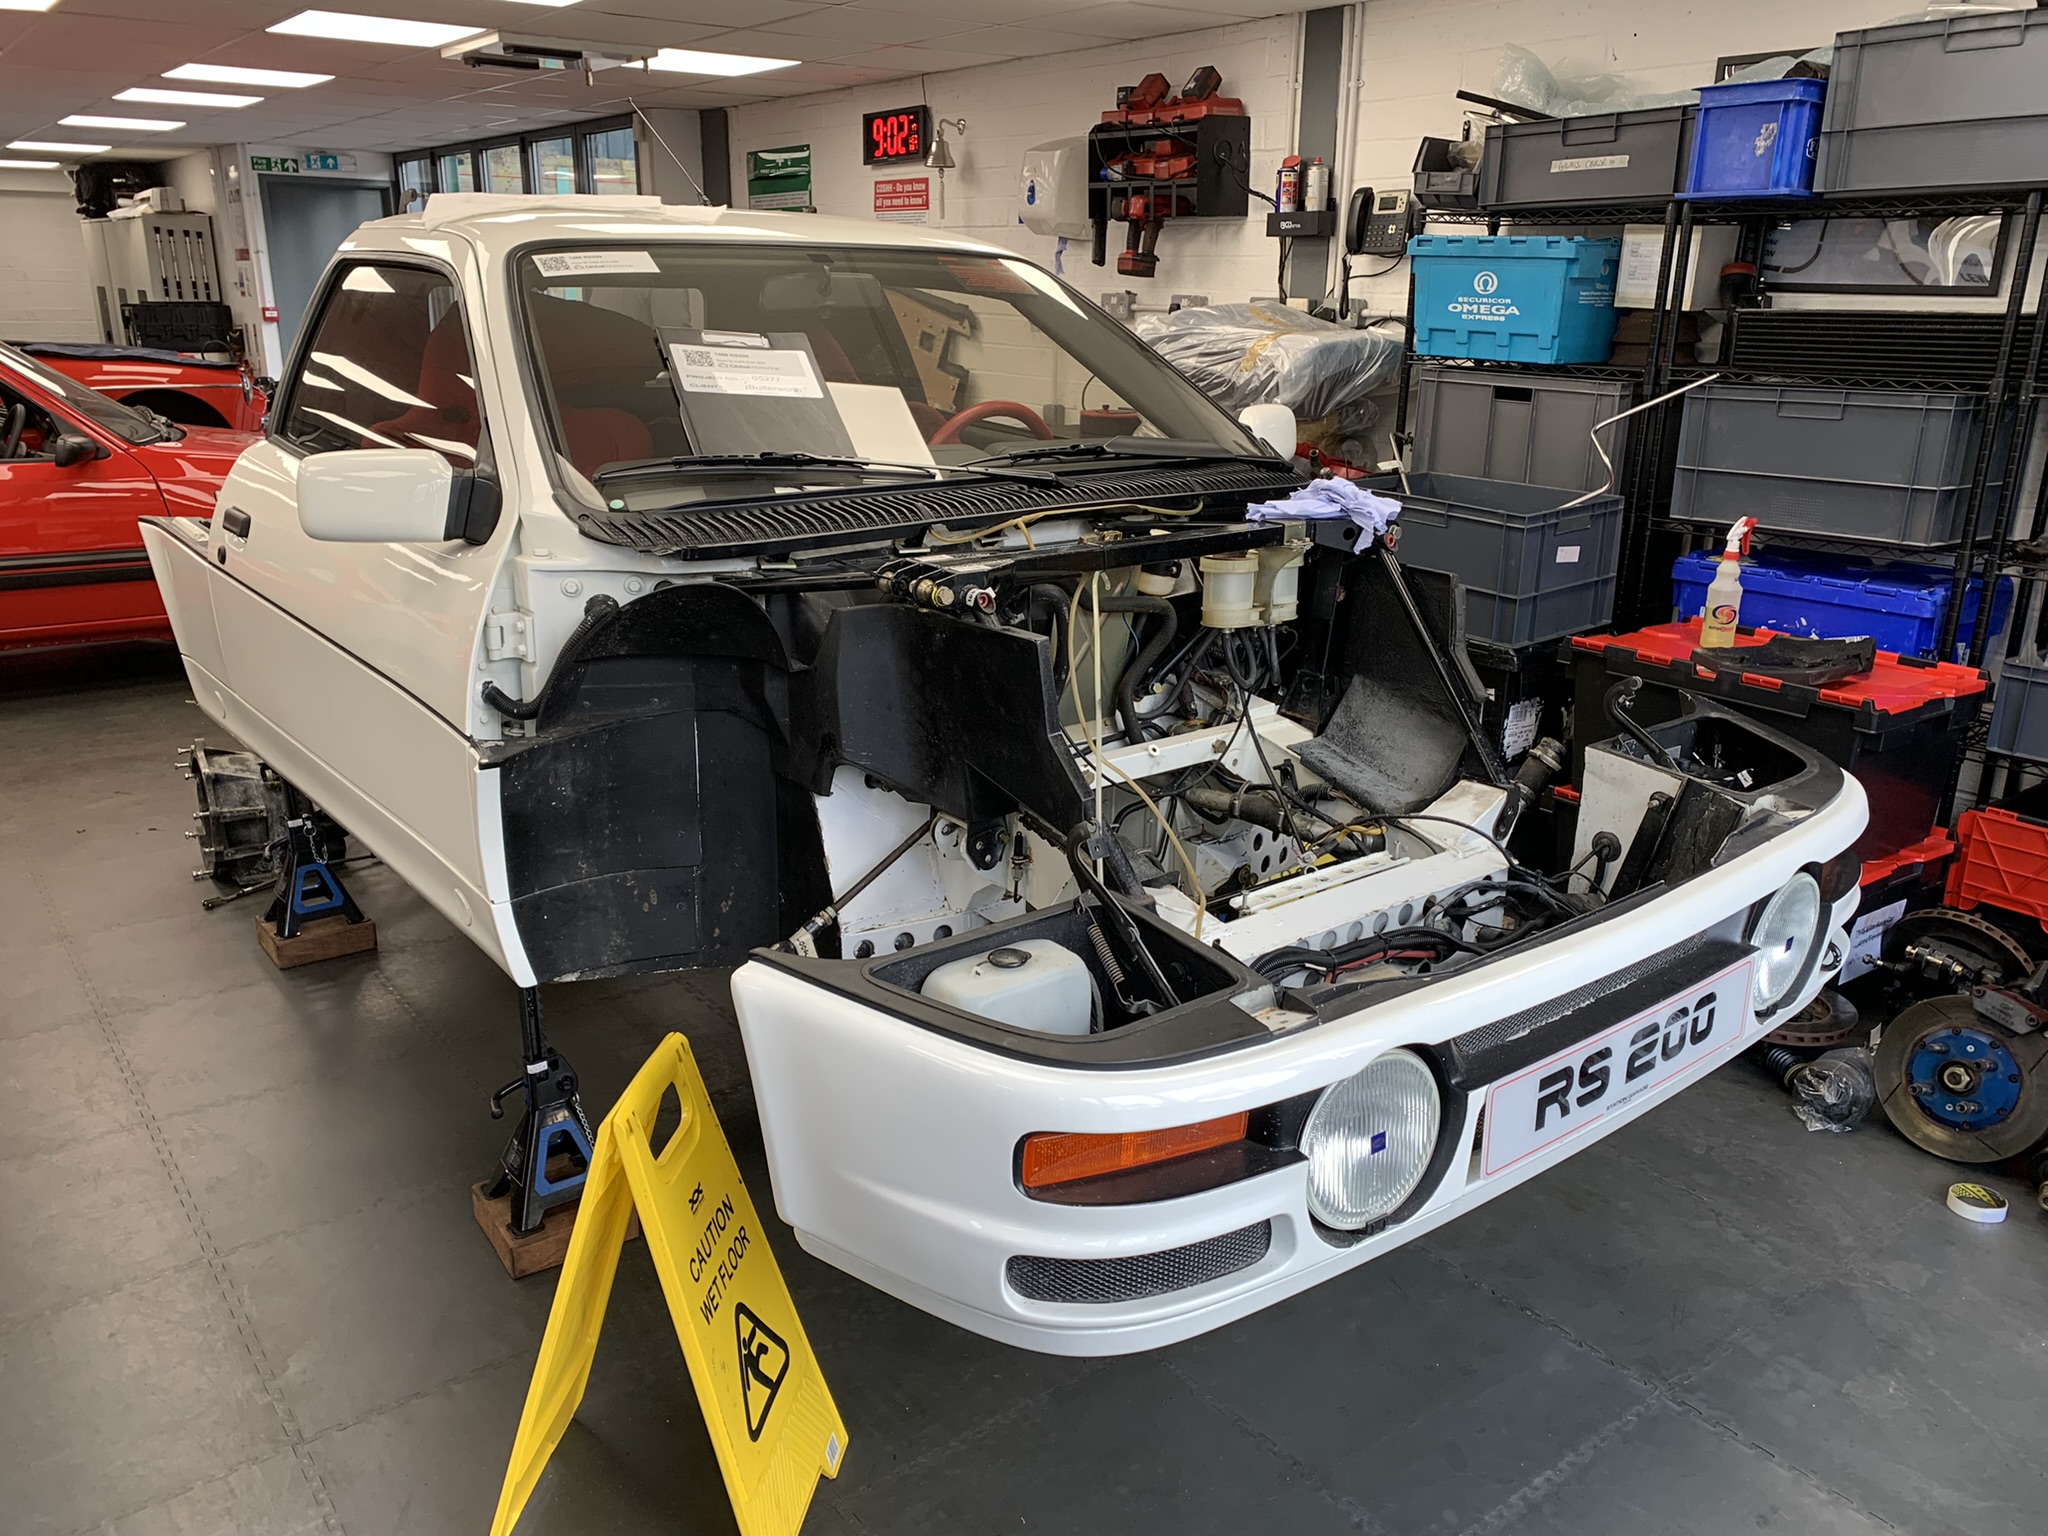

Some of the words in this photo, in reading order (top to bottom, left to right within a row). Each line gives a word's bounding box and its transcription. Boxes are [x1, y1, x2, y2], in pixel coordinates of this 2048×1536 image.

[883, 199, 892, 208] you
[892, 197, 904, 206] need
[903, 184, 913, 193] you
[913, 182, 927, 191] know
[1447, 303, 1520, 316] OMEGA
[1535, 1046, 1613, 1132] RS
[1625, 991, 1717, 1085] 200
[689, 1193, 735, 1283] CAUTION
[700, 1275, 722, 1326] WET
[718, 1226, 750, 1290] FLOOR
